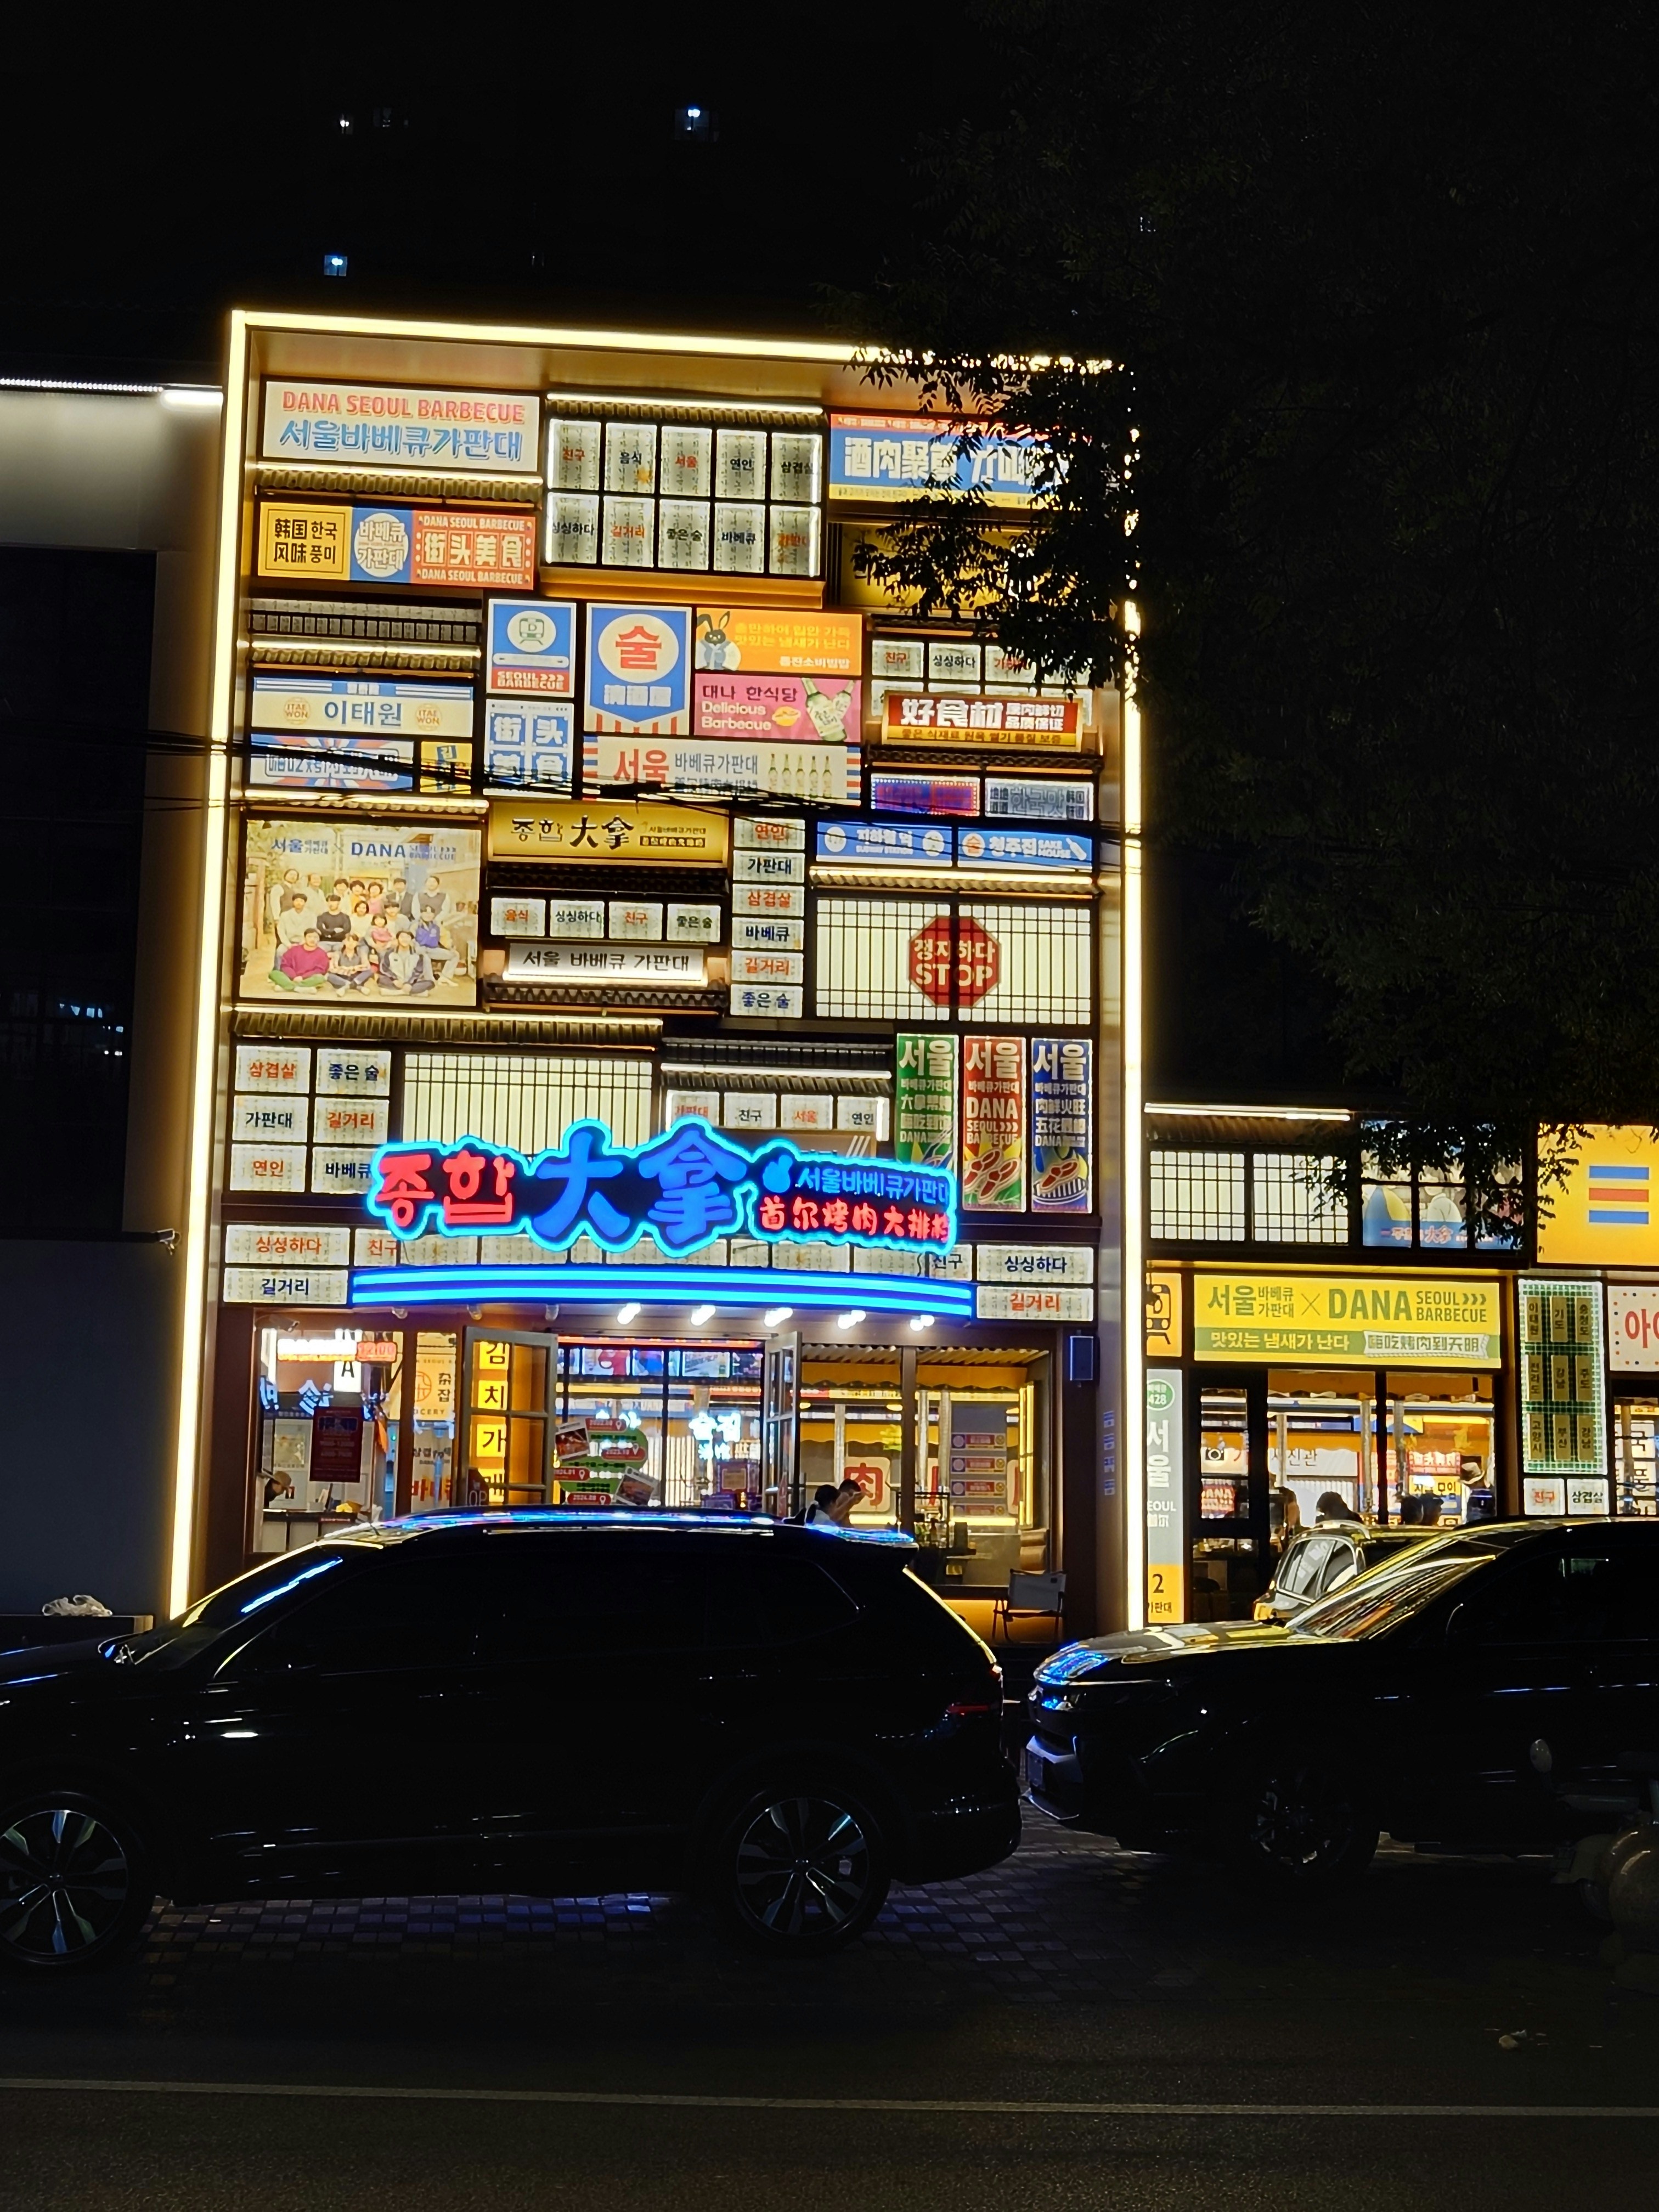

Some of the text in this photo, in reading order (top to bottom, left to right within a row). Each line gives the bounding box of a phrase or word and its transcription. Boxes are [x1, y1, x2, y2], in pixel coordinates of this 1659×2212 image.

[283, 391, 525, 424] DANA SEOUL BARBECUE
[280, 420, 522, 461] 서울바베큐가판대
[562, 449, 585, 460] 친구
[619, 452, 642, 464] 음식
[675, 456, 698, 468] 서울
[730, 459, 754, 471] 연인
[274, 518, 338, 540] 韩国 한국
[424, 515, 525, 531] DANA SEOUL BARBECUE
[359, 521, 406, 543] 바베큐
[612, 526, 645, 538] 길거리
[274, 543, 336, 564] 风味 풍미
[424, 532, 522, 568] 街头美食
[357, 549, 404, 571] 가판대
[421, 569, 523, 584] DANA SEOUL BARBECUE
[616, 626, 662, 670] 술
[933, 655, 976, 668] 싱싱하다
[498, 671, 538, 680] SEOUL
[703, 685, 797, 702] 대나 한식당
[324, 701, 402, 726] 이태원
[702, 702, 766, 715] Delicious
[901, 699, 1003, 729] 好食材
[701, 716, 772, 730] Barbecue
[675, 753, 758, 774] 바베큐가판대
[511, 815, 634, 850] 종합 大拿
[755, 823, 786, 840] 연인
[352, 843, 405, 857] DANA
[747, 858, 792, 874] 가판대
[505, 909, 528, 922] 음식
[555, 910, 601, 923] 싱싱하다
[624, 912, 648, 925] 친구
[746, 926, 789, 942] 바베큐
[523, 951, 689, 972] 서울 바베큐 가판대
[744, 957, 789, 975] 길거리
[916, 964, 993, 986] STOP
[742, 991, 771, 1008] 좋은
[899, 1040, 952, 1077] 서울
[966, 1042, 1020, 1079] 서울
[1034, 1043, 1087, 1081] 서울
[249, 1062, 296, 1079] 삼겹살
[329, 1064, 359, 1081] 좋은
[794, 1110, 817, 1122] 서울
[966, 1097, 1018, 1119] DANA
[246, 1112, 292, 1128] 가판대
[328, 1112, 374, 1129] 길거리
[852, 1113, 874, 1125] 연인
[967, 1120, 998, 1132] SEOUL
[900, 1131, 927, 1143] DANA
[1035, 1135, 1061, 1146] DANA
[253, 1160, 284, 1177] 연인
[325, 1163, 371, 1178] 바베큐
[376, 1128, 747, 1244] 종합 大拿
[368, 1239, 397, 1257] 친구
[1005, 1256, 1067, 1273] 싱싱하다
[261, 1278, 309, 1295] 길거리
[1259, 1286, 1294, 1301] 바베큐
[1010, 1293, 1062, 1312] 길거리
[1207, 1285, 1256, 1316] 서울
[1328, 1289, 1412, 1321] DANA
[1417, 1291, 1459, 1305] SEOUL
[1259, 1304, 1294, 1318] 가판대
[1417, 1307, 1487, 1322] BARBECUE
[1211, 1332, 1350, 1351] 맛있는 냄새가 난다
[1148, 1500, 1176, 1511] EOUL
[1153, 1573, 1164, 1593] 2
